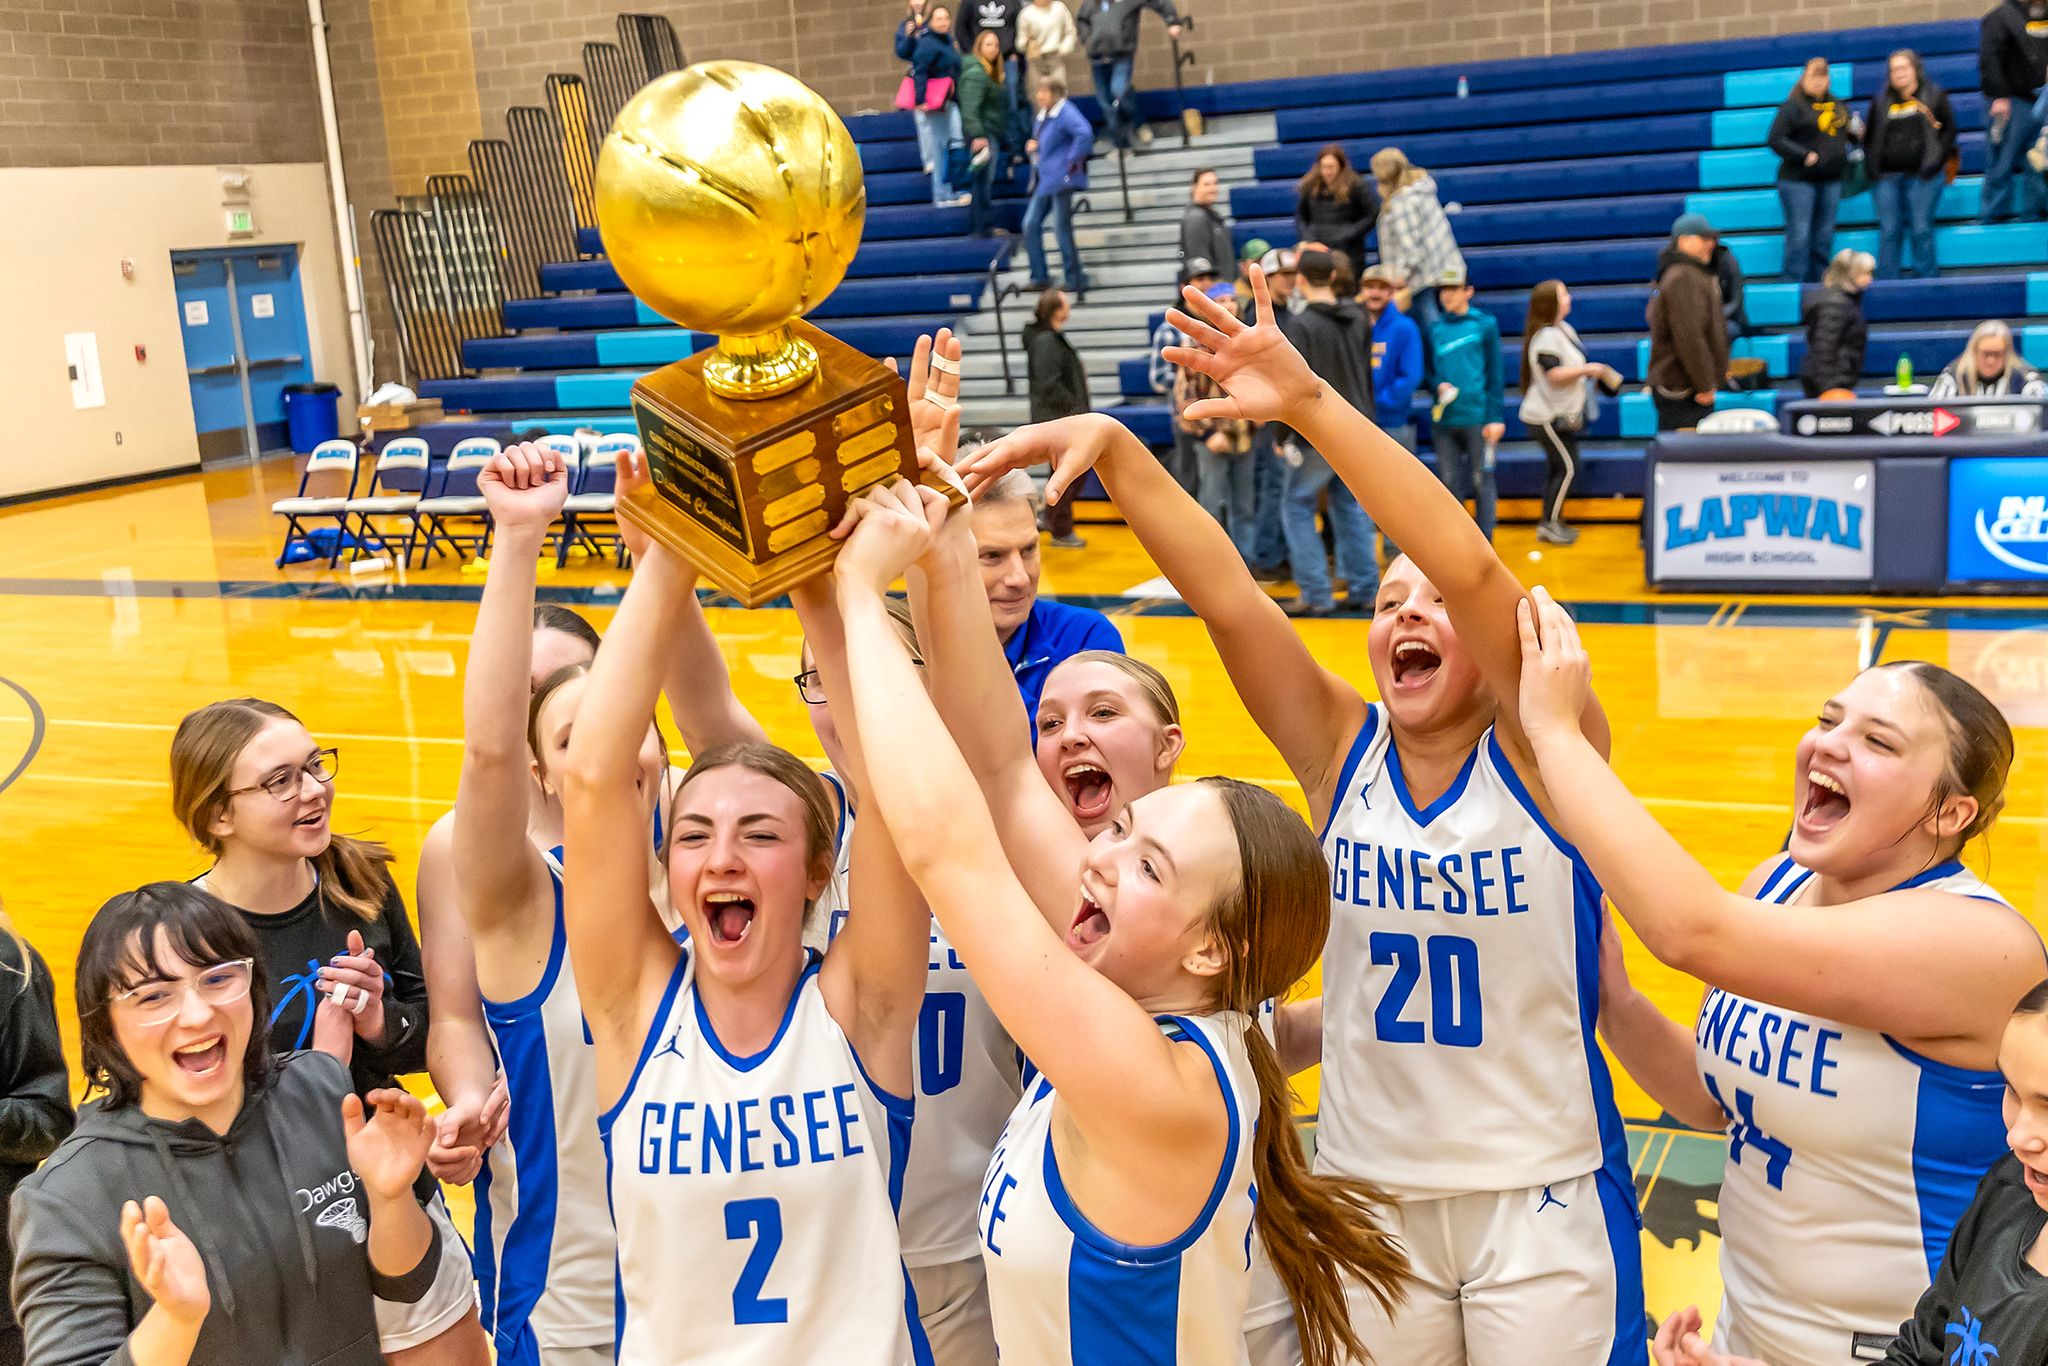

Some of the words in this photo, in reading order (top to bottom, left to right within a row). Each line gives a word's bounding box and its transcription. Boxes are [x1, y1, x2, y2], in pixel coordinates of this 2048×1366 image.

[1719, 471, 1785, 483] WELCOME
[1791, 471, 1809, 482] TO
[1665, 491, 1862, 551] LAPWAI
[1705, 552, 1745, 563] HIGH
[1750, 551, 1817, 564] SCHOOL
[1334, 837, 1529, 916] GENESEE
[1369, 931, 1483, 1048] 20
[639, 1083, 864, 1175] GENESEE
[724, 1197, 788, 1325] 2
